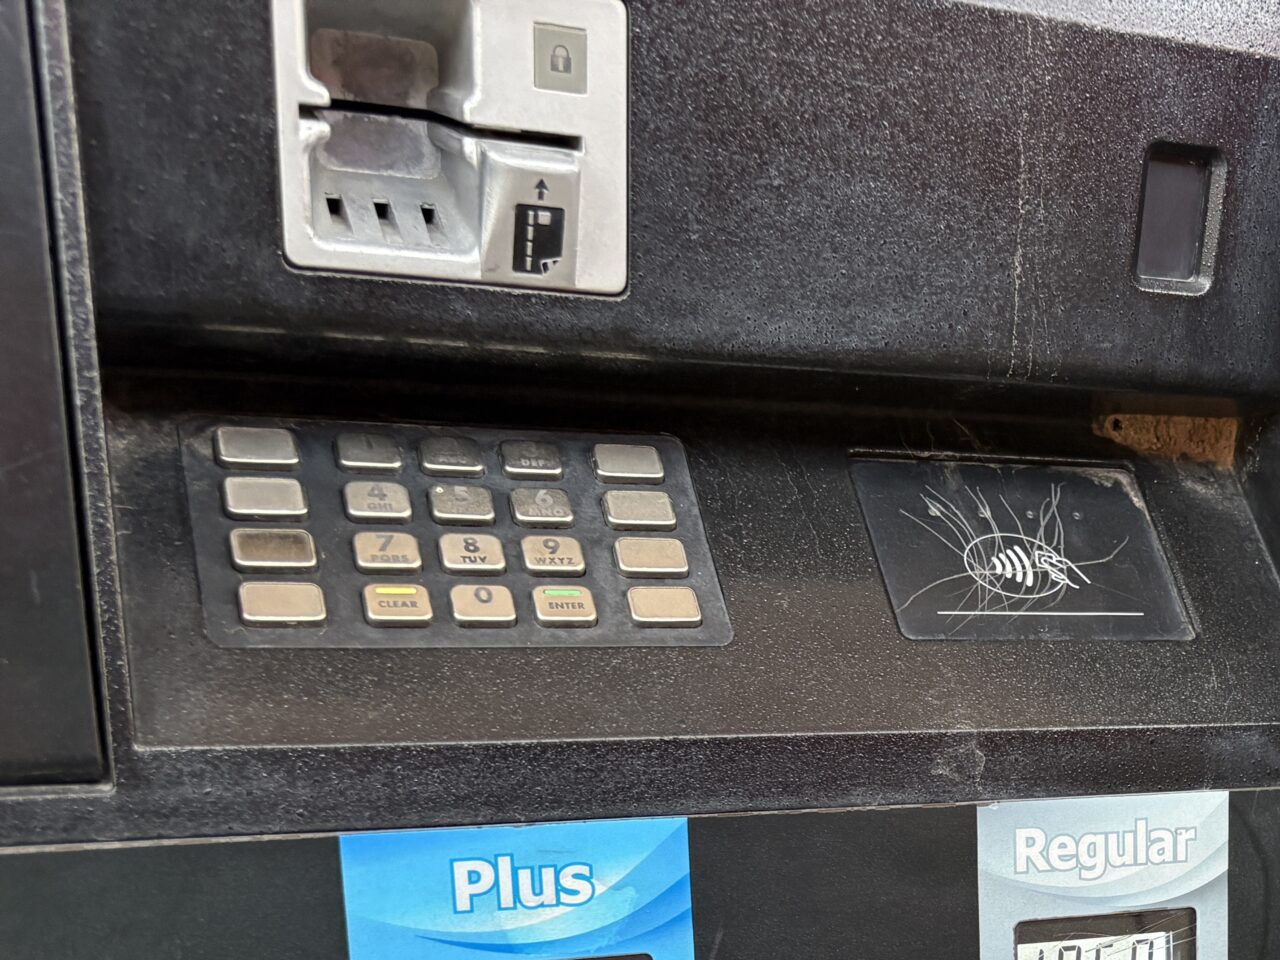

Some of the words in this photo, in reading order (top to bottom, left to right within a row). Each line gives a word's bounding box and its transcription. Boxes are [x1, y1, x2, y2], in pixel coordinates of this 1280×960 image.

[367, 484, 387, 501] 4
[454, 486, 468, 502] 5
[535, 489, 553, 507] 6
[367, 502, 393, 511] GHI
[376, 535, 394, 552] 7
[463, 537, 480, 553] 8
[543, 538, 560, 554] 9
[534, 557, 575, 565] WXYZ
[474, 586, 492, 603] 0
[378, 600, 419, 608] CLEAR
[548, 602, 586, 610] ENTER
[1014, 818, 1196, 881] Regular
[450, 853, 598, 914] Plus
